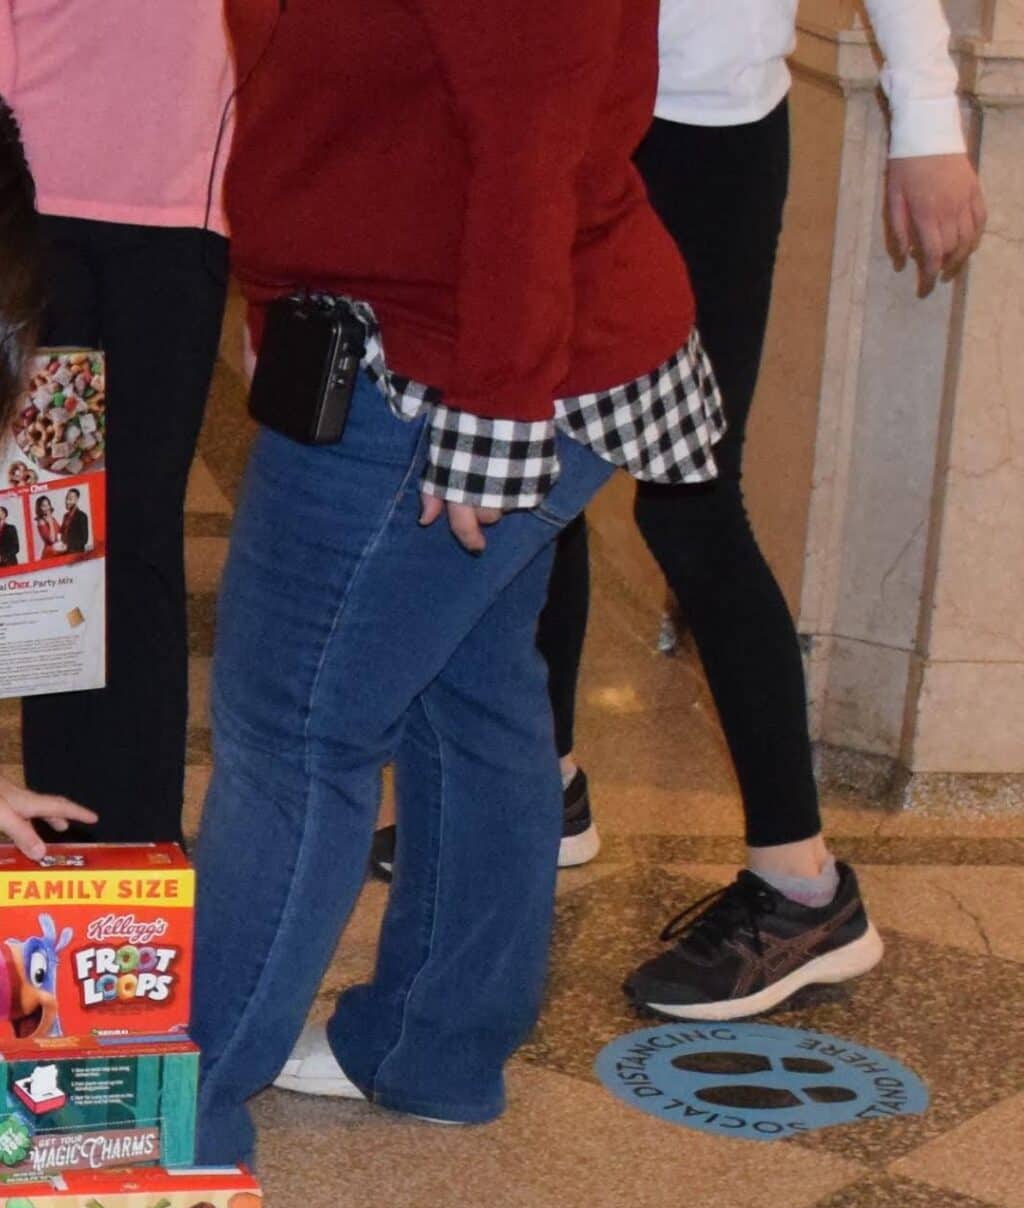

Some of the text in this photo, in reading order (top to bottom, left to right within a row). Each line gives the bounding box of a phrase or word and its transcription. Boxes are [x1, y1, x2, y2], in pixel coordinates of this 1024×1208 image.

[32, 580, 56, 589] Party
[58, 576, 74, 585] Mix
[7, 878, 179, 900] FAMILY SIZE
[87, 914, 168, 943] Kellogg's
[76, 945, 176, 979] FROOT
[82, 973, 173, 1006] LOOPS
[615, 1028, 737, 1098] DISTANCING
[795, 1038, 908, 1119] TAND HERE
[29, 1133, 156, 1171] MAGIC CHARMS
